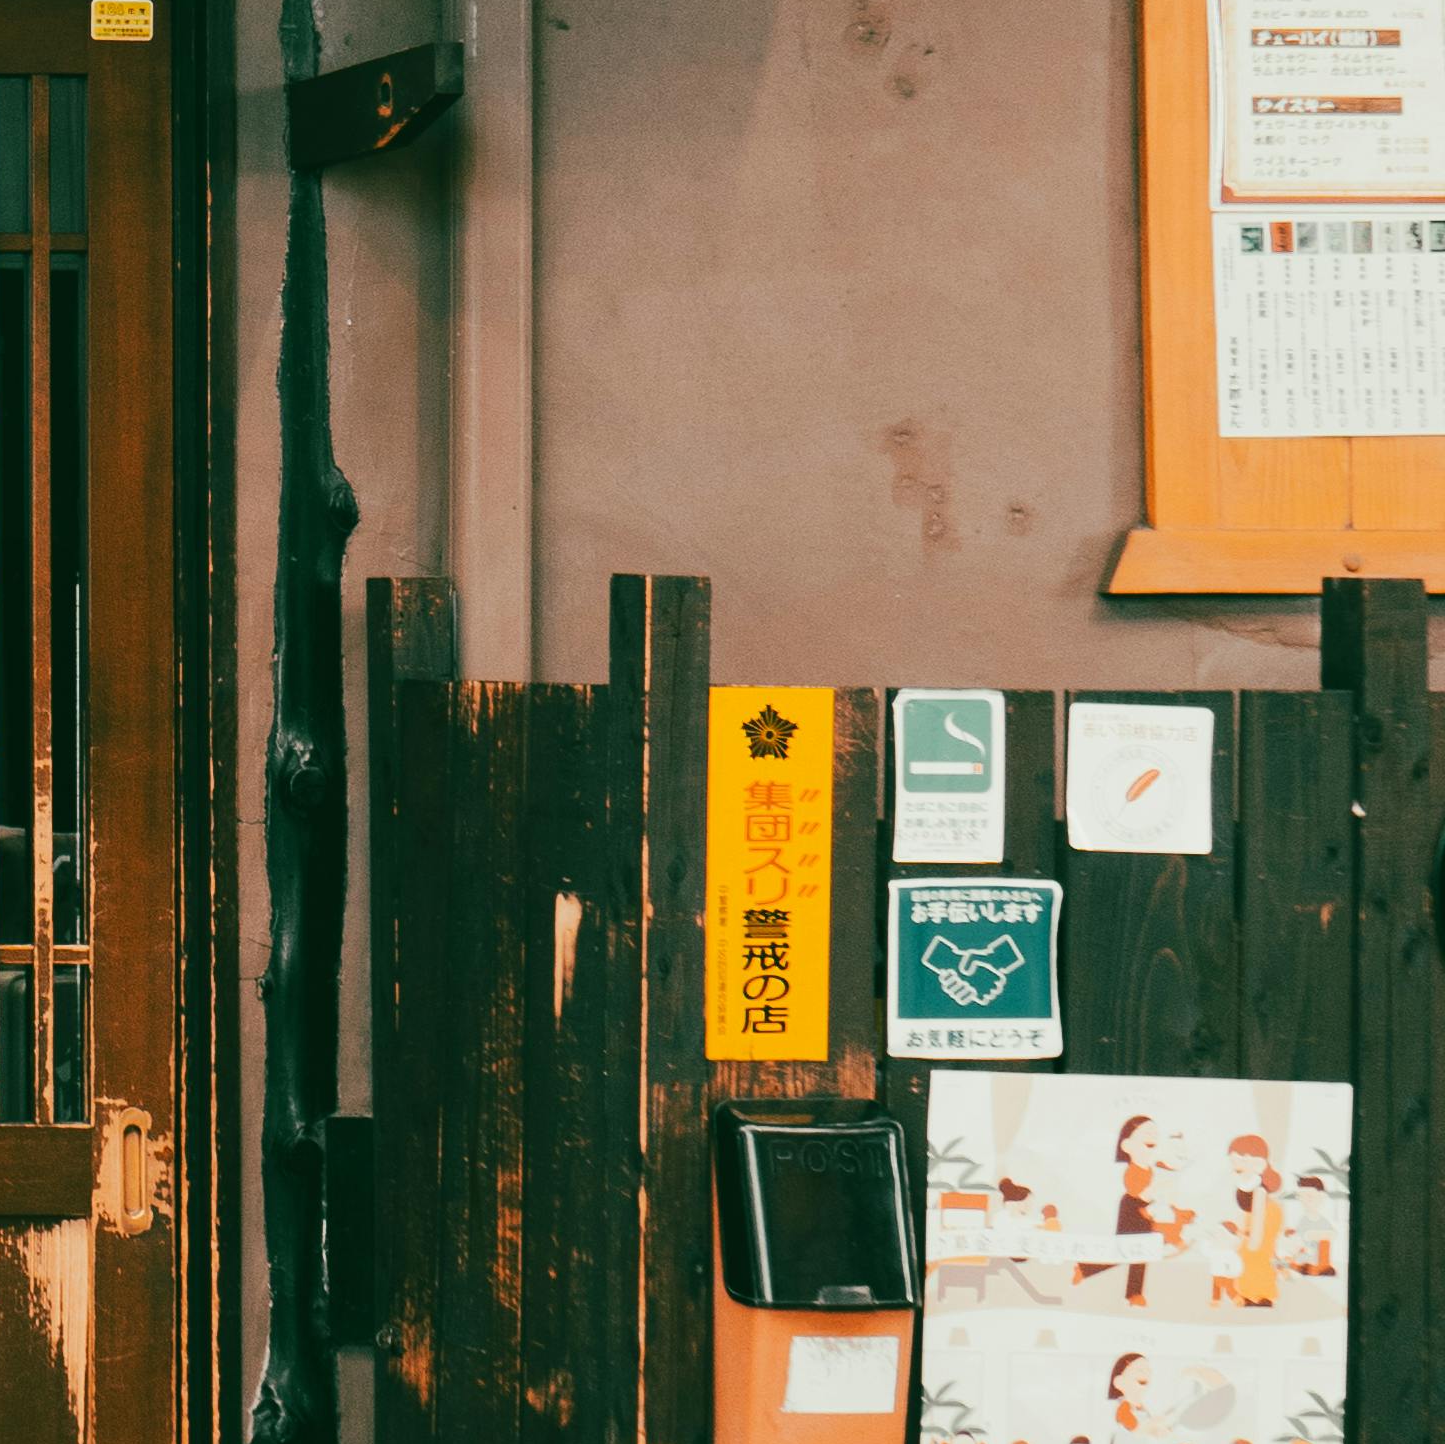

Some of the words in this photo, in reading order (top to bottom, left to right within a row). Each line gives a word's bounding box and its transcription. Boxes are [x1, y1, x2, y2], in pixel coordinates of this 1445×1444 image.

[742, 781, 794, 1034] 集団スリ警戒の店
[910, 901, 1044, 924] お手伝いします
[906, 1027, 1045, 1049] お気軽にどうぞ
[769, 1140, 888, 1177] POST
